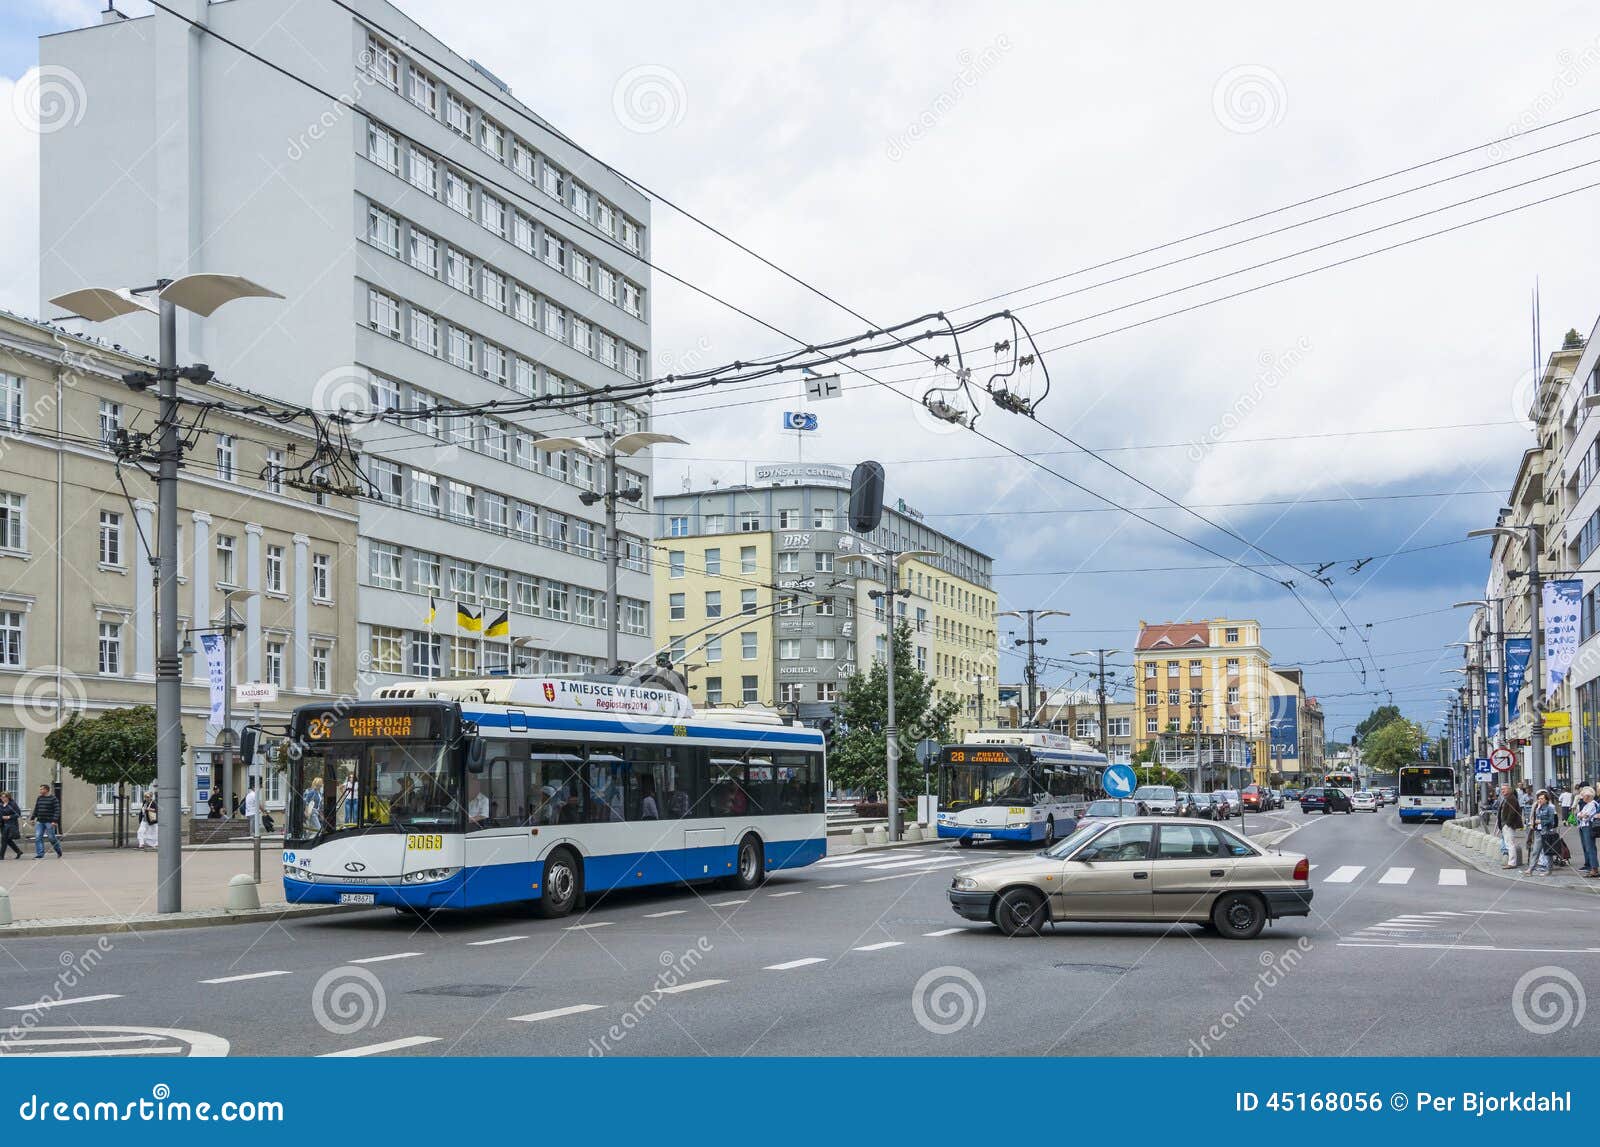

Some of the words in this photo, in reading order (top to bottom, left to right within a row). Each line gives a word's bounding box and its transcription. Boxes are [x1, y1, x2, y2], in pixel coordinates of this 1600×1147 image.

[783, 534, 811, 546] DBS
[569, 683, 613, 696] MIEJSCE
[616, 687, 627, 696] W
[630, 689, 673, 702] EUROPIE
[596, 698, 631, 710] Regiostars
[632, 702, 648, 711] 2014
[951, 751, 965, 762] 28
[1479, 760, 1487, 770] P
